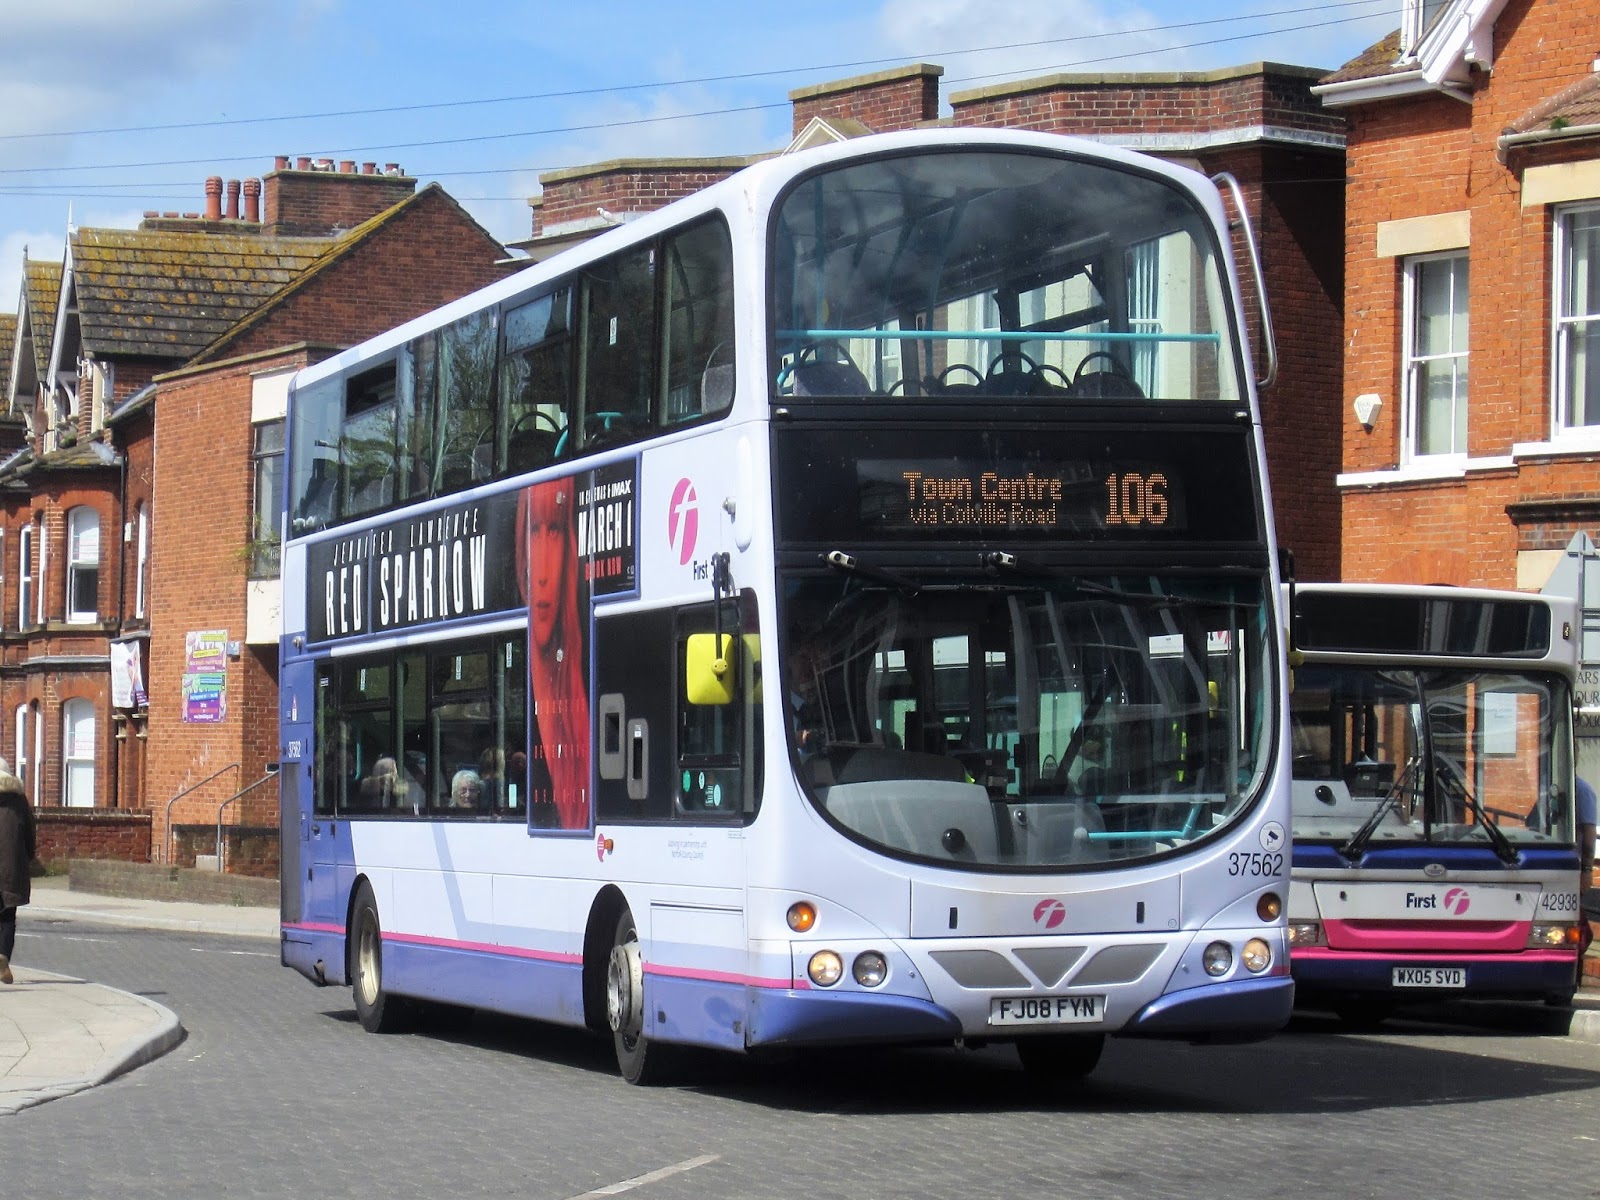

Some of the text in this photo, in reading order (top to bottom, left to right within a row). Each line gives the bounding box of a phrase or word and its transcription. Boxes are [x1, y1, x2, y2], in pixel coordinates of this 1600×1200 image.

[611, 479, 632, 498] IMAX
[903, 471, 1062, 500] Town Centre
[1105, 472, 1168, 525] 106
[909, 502, 1056, 524] via Colville Road
[333, 507, 479, 566] JENNIFER LAWRENCE
[578, 501, 623, 557] MARCH
[693, 559, 708, 581] First
[325, 534, 486, 636] RED SPARROW
[1228, 852, 1284, 877] 37562
[1406, 892, 1436, 909] First
[1541, 893, 1578, 911] 42938
[1398, 970, 1460, 985] WX05 SVD
[1000, 997, 1095, 1019] FJ08 FYN
